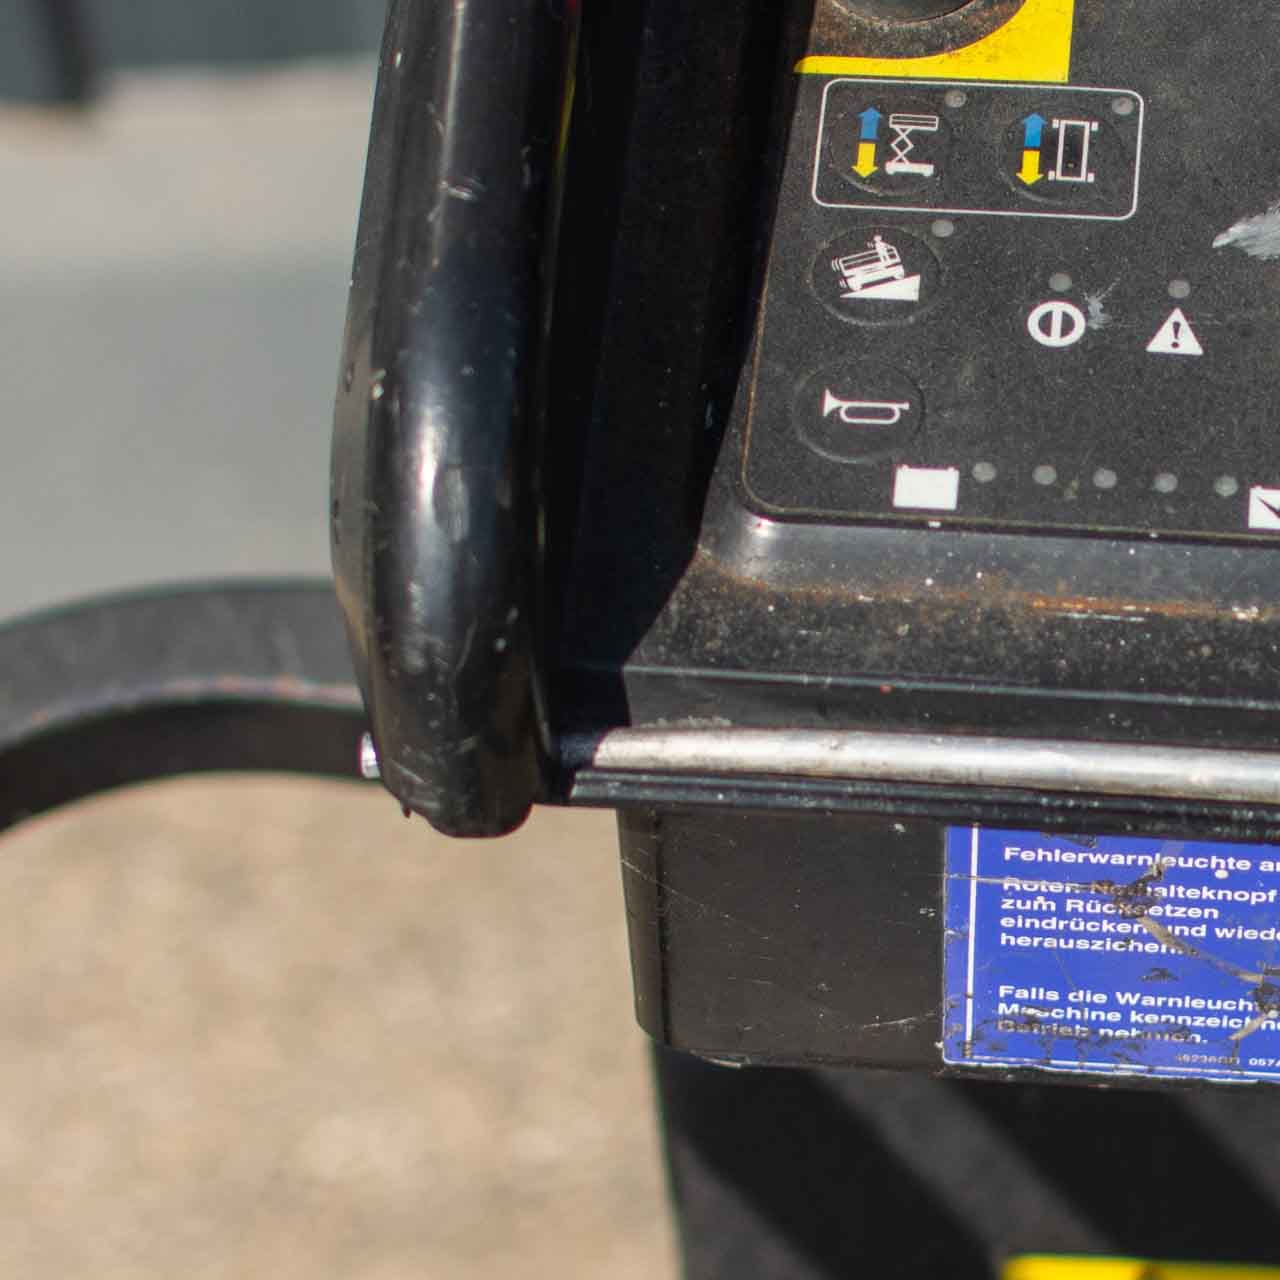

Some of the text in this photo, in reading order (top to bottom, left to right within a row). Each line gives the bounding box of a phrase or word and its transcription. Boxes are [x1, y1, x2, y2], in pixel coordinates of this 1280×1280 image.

[1003, 847, 1252, 871] Fehlerwarnleuchte
[1000, 897, 1057, 912] zum
[1000, 915, 1148, 934] eindrücken
[1162, 923, 1207, 938] nd
[999, 984, 1060, 1001] Falls
[1068, 989, 1107, 1004] die
[1115, 991, 1264, 1012] Warnleuch
